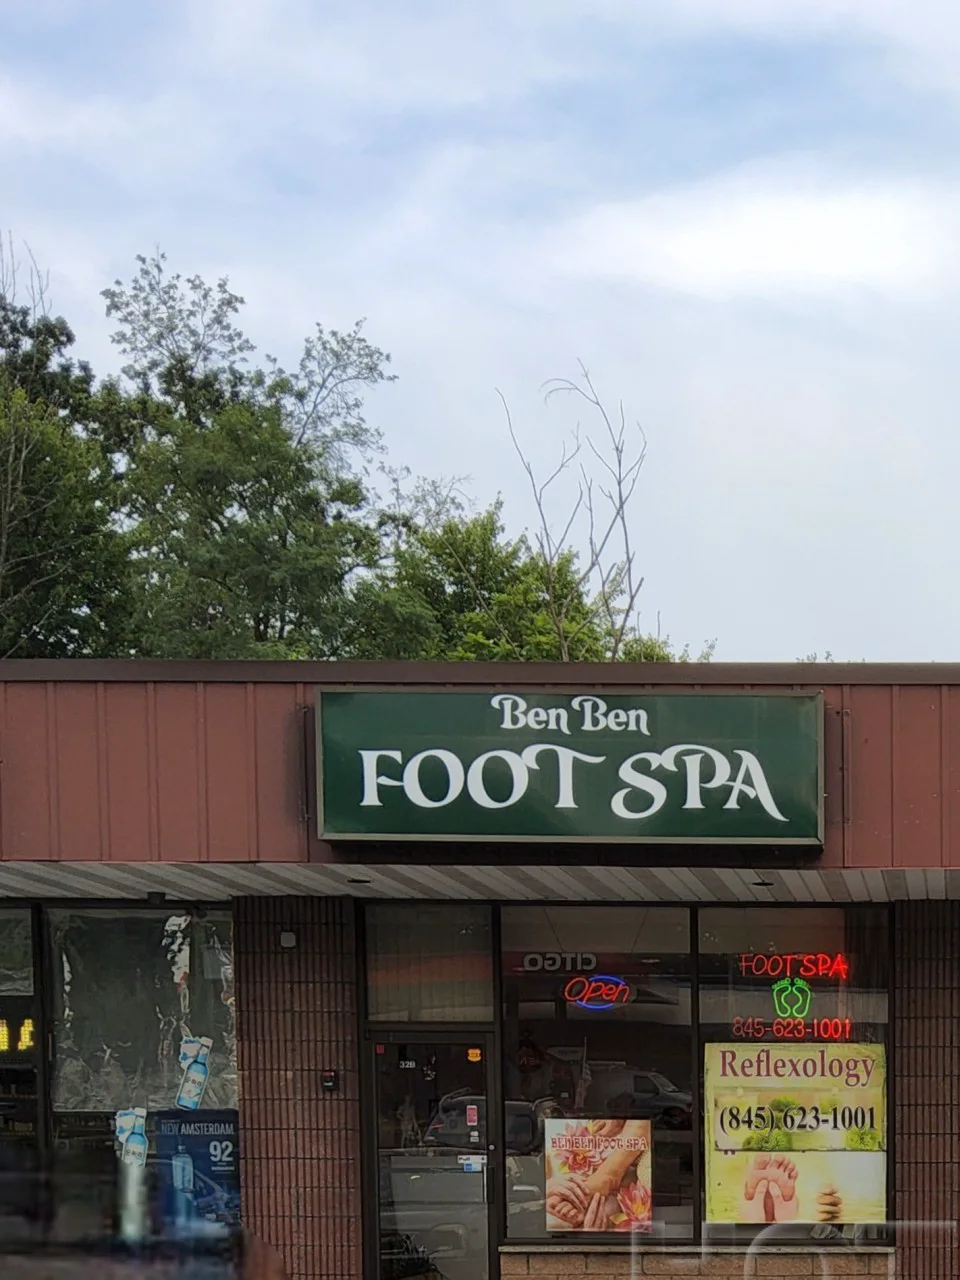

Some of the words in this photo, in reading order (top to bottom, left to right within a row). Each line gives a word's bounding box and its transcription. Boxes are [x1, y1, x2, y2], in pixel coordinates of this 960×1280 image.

[490, 694, 572, 735] Ben
[571, 695, 651, 736] Ben
[358, 743, 606, 809] FOOT
[610, 743, 790, 822] SPA
[739, 953, 799, 977] FOOT
[800, 953, 850, 979] SPA
[564, 976, 630, 1004] Open
[732, 1016, 851, 1040] 845-623-1001
[719, 1048, 876, 1087] Reflexology
[161, 1123, 179, 1135] NEW
[181, 1122, 235, 1135] AMSTERDAM
[720, 1105, 775, 1136] (845)
[783, 1105, 876, 1131] 623-1001
[209, 1140, 234, 1162] 92
[552, 1137, 573, 1149] BEN
[574, 1137, 595, 1149] BEN
[626, 1137, 647, 1151] SPA
